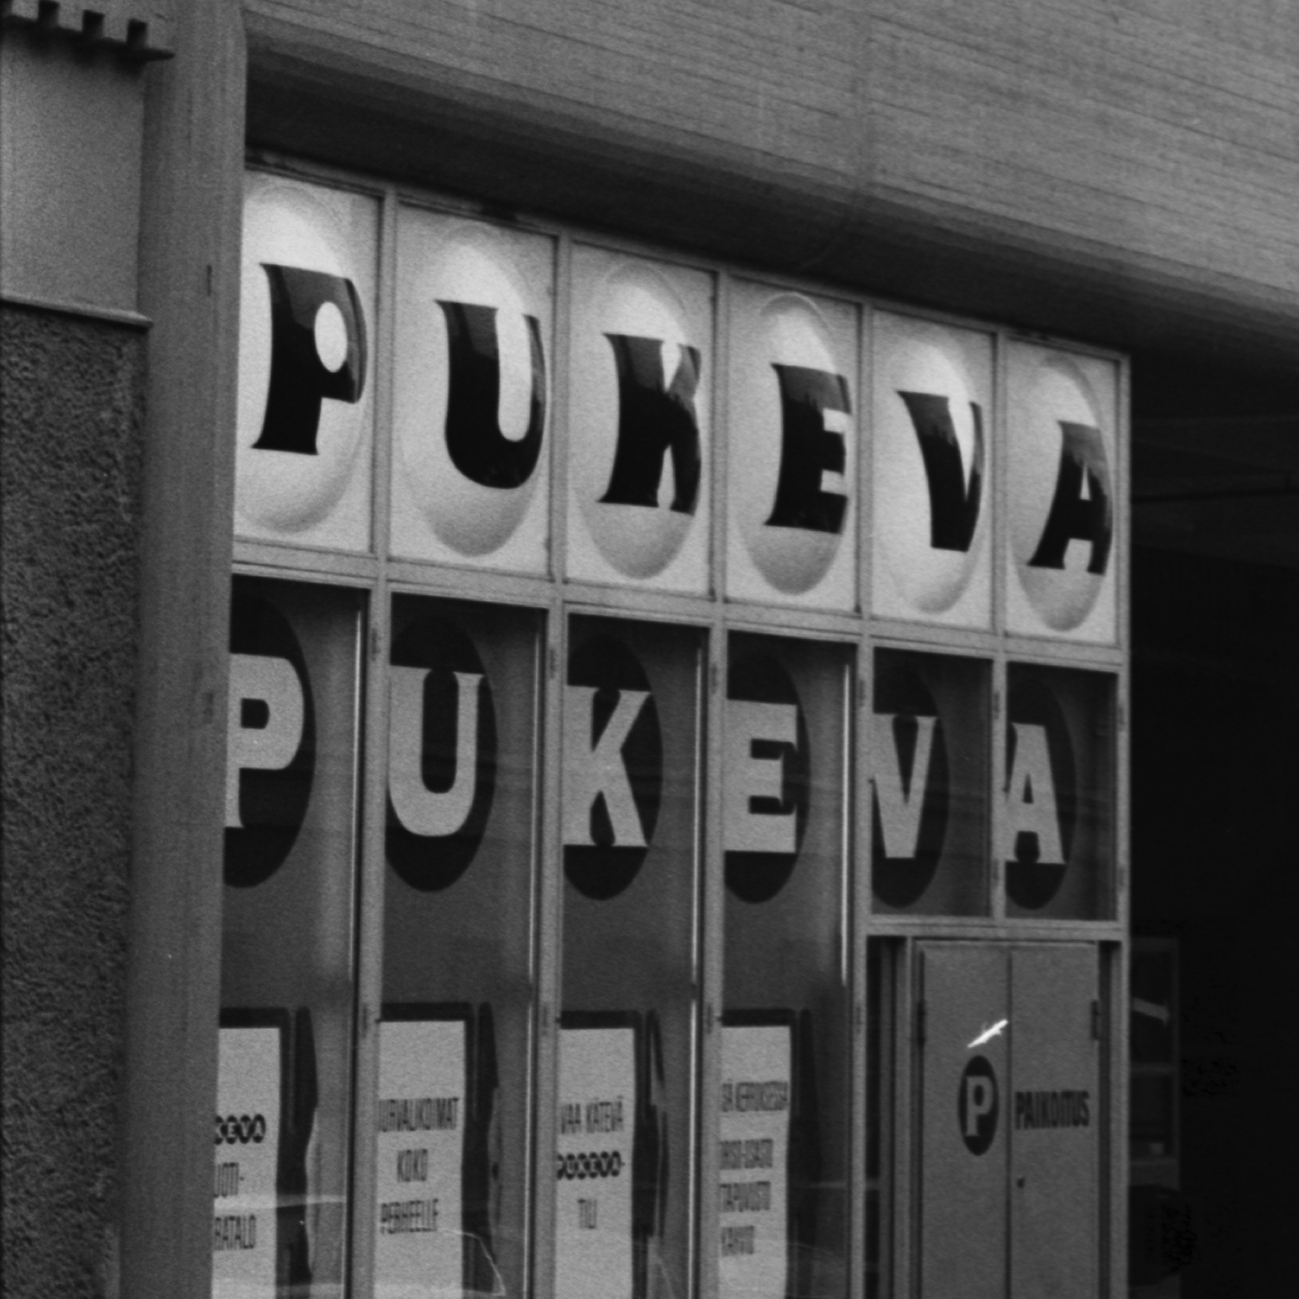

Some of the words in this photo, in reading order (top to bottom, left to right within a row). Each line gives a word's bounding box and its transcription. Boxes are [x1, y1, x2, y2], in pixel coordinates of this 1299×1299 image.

[250, 262, 1114, 576] PUKEVA
[223, 651, 1067, 864] PUKEVA
[965, 1075, 994, 1137] P
[1014, 1090, 1090, 1130] PAIKOITUS
